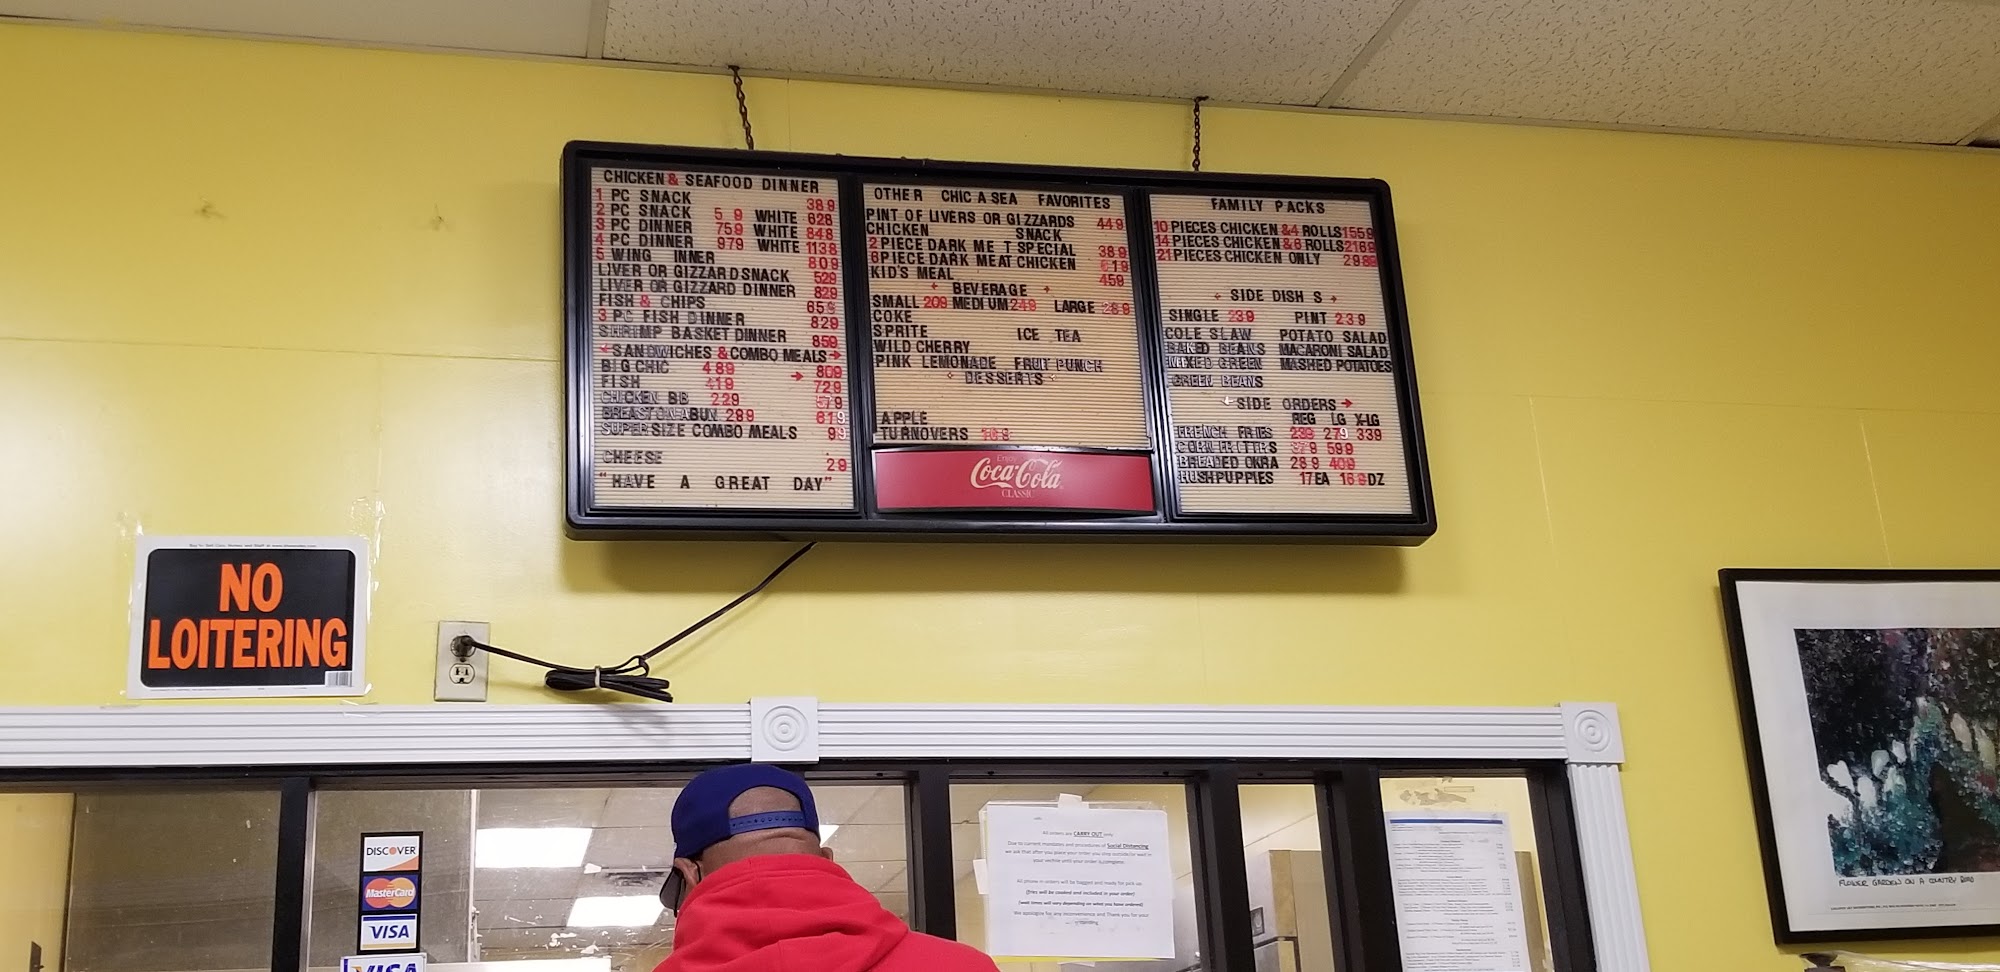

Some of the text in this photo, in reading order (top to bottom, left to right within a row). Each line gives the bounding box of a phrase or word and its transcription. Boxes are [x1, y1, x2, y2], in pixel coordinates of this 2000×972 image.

[604, 170, 819, 193] CHICKEN SEAFOOD DINNER
[612, 189, 835, 211] PC SNACK 389
[874, 187, 1110, 209] OTHER CHIC SEA FAVORITES
[1211, 198, 1325, 213] FAMILY PACKS
[611, 204, 833, 226] PC SNACK WHITE 628
[866, 208, 1123, 230] PINT OF LIVERS OR GIZZARDS 449
[611, 219, 833, 240] PC DINNER 759 WHITE 848
[866, 222, 1062, 241] CHICKEN SNACK
[1171, 221, 1278, 235] PIECES CHICKEN
[610, 234, 837, 255] PC DINNER 979 WHITE 1138
[881, 237, 1076, 256] PIECE DARK SPECIAL
[1173, 235, 1280, 249] PIECES CHICKEN
[612, 248, 838, 270] WING INNER 809
[881, 251, 1076, 270] PIECE DARK MEAT CHICKEN
[1174, 249, 1321, 265] PIECES CHICKEN ONLY
[598, 263, 789, 282] LIVER OR GIZZARD SNACK
[871, 265, 954, 280] KID'S MEAL
[600, 279, 796, 298] LIVER OR GIZZARD DINNER
[953, 282, 1027, 296] BEVERAGE
[1231, 289, 1303, 302] SIDE DISH
[599, 294, 705, 309] FISH CHIPS
[873, 295, 1095, 313] SMALL MEDIUM LARGE
[613, 310, 839, 330] PC FISH DINNER 829
[874, 310, 912, 322] COKE
[1169, 309, 1366, 325] SINGLE PINT 239
[599, 325, 786, 343] SHRIMP BASKET DINNER
[873, 325, 1081, 342] SPRITE ICE TEA
[1165, 328, 1386, 344] COLE SLAW POTATO SALAD
[613, 345, 827, 363] SANDWICHES COMBO MEALS
[874, 340, 970, 353] WILD CHERRY
[1166, 342, 1388, 358] BAKED BEANS MACARONI SALAD
[601, 359, 669, 373] BIG CHIC
[875, 355, 1102, 372] PINK LEMONADE FRUIT PUNCH
[1219, 357, 1392, 372] GREEN MASHED POTATOES
[601, 375, 841, 394] FISH 729
[965, 372, 1043, 385] DESSERTS
[1172, 375, 1263, 387] GREEN BEANS
[601, 391, 739, 406] CHICKEN 229
[1237, 397, 1336, 411] SIDE ORDERS
[881, 411, 927, 425] APPLE
[1293, 413, 1346, 425] REG LG
[692, 425, 797, 440] COMBO MEALS
[881, 427, 968, 440] TURNOVERS
[1176, 426, 1382, 440] FRENCH FRIES 339
[603, 451, 663, 464] CHEESE
[997, 455, 1016, 463] Enjoy
[1180, 456, 1278, 468] BREADED OKRA
[970, 457, 1062, 489] Coca-Cola
[1180, 471, 1273, 485] HUSHPUPPIES
[716, 475, 770, 491] GREAT
[1002, 489, 1034, 498] CLASSIC
[219, 562, 283, 612] NO
[148, 618, 347, 669] LOITERING
[367, 847, 416, 855] DISCOVER
[366, 888, 415, 898] MasterCard
[369, 925, 409, 939] VISA
